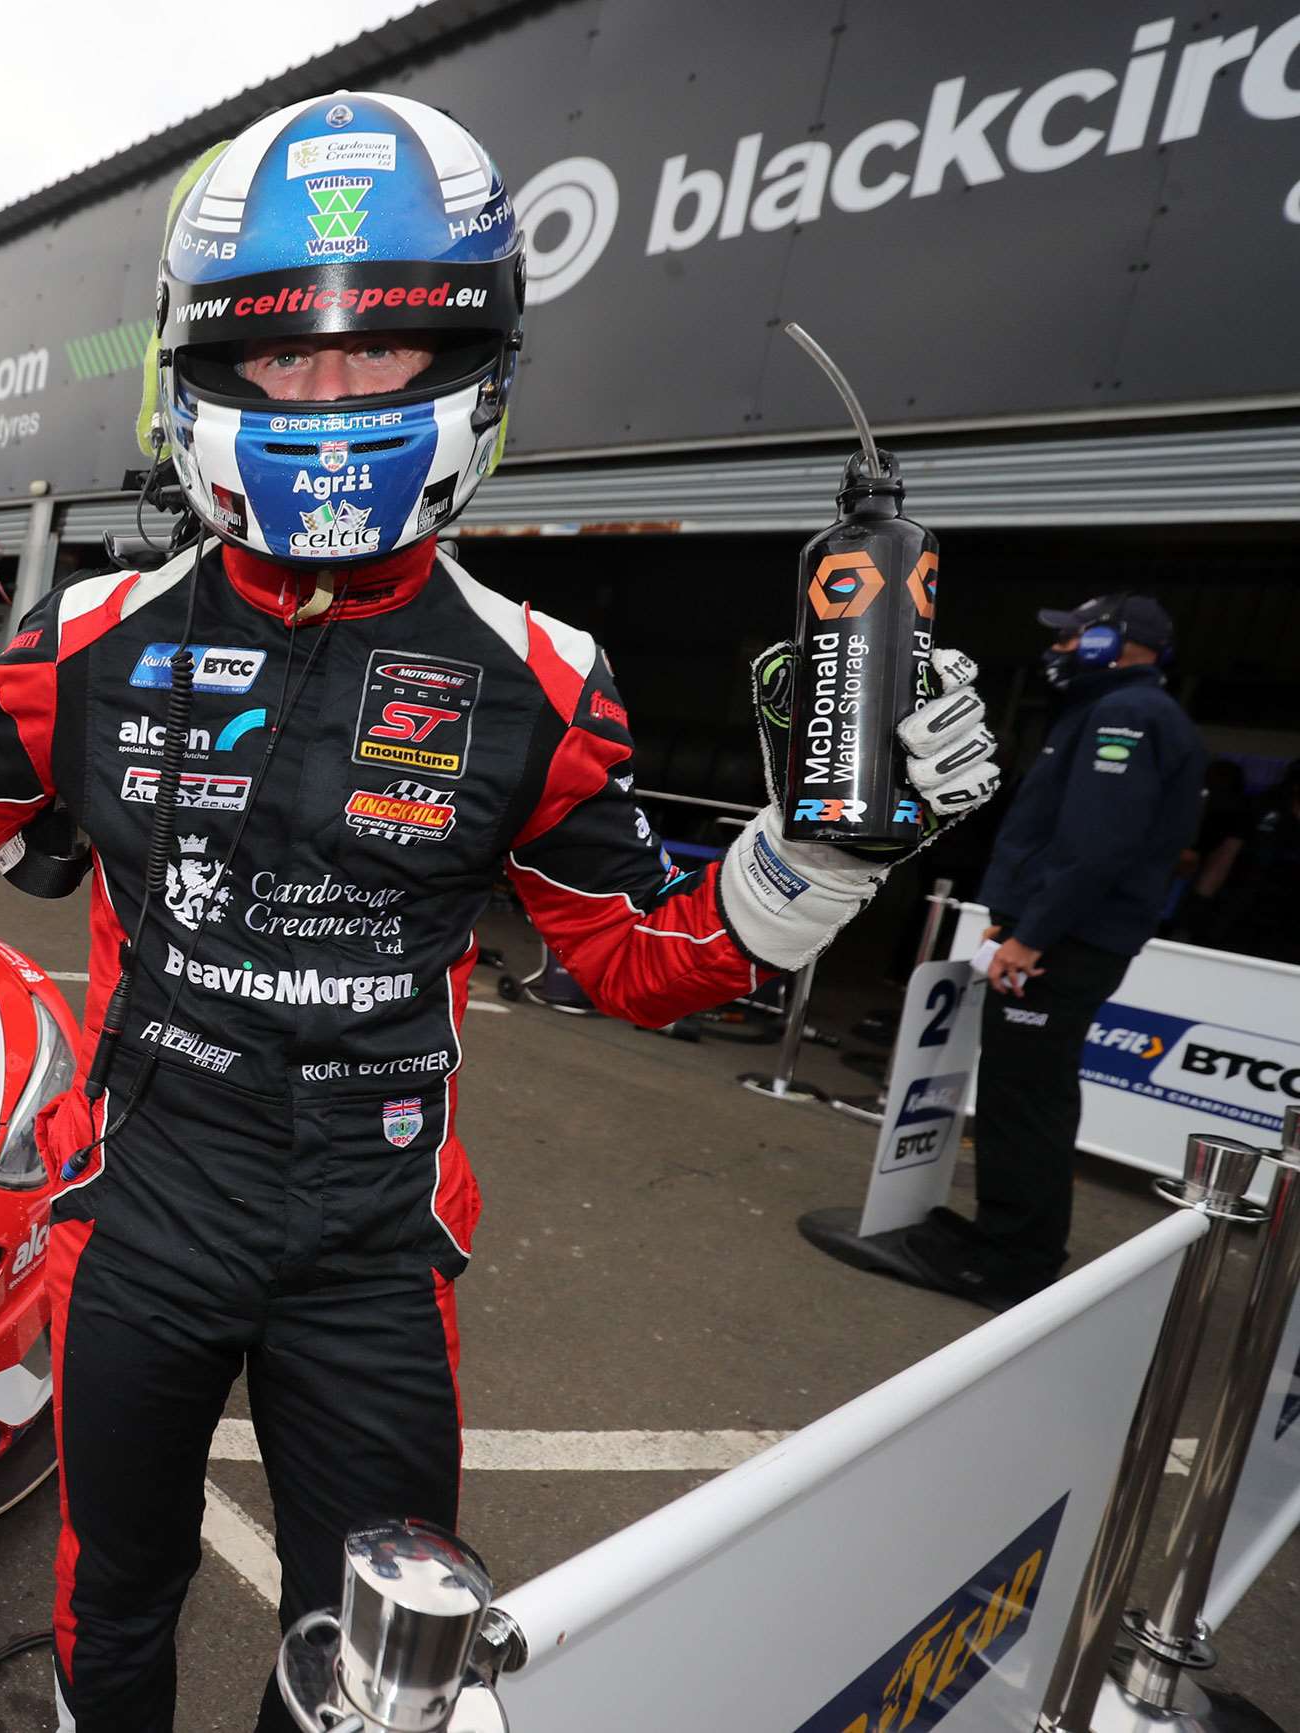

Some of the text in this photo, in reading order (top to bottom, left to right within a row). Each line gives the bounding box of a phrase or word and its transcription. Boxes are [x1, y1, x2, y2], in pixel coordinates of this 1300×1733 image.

[326, 151, 392, 160] Creameries
[327, 141, 390, 151] Cardowan
[307, 175, 373, 190] William
[308, 236, 367, 256] Waugh
[270, 412, 402, 433] @RORYBUTCHER
[292, 465, 373, 500] Agrii
[203, 657, 255, 677] BTCC
[398, 668, 466, 686] MOTORBASE
[368, 701, 461, 742] ST
[804, 632, 841, 784] McDonald
[833, 634, 869, 784] Water Storage
[118, 716, 210, 750] alcn
[365, 745, 454, 767] mountune
[352, 795, 446, 826] KNOCKHILL
[353, 815, 397, 832] Racing
[251, 871, 406, 908] Cardowan
[244, 902, 402, 937] Creameries
[374, 940, 404, 955] Ltd
[1084, 1022, 1150, 1054] kFit
[301, 1050, 450, 1082] RORY BUTCHER
[1132, 1083, 1164, 1097] CAR
[1167, 1091, 1284, 1128] CHAMPIONSHI
[895, 1130, 938, 1159] BTCC
